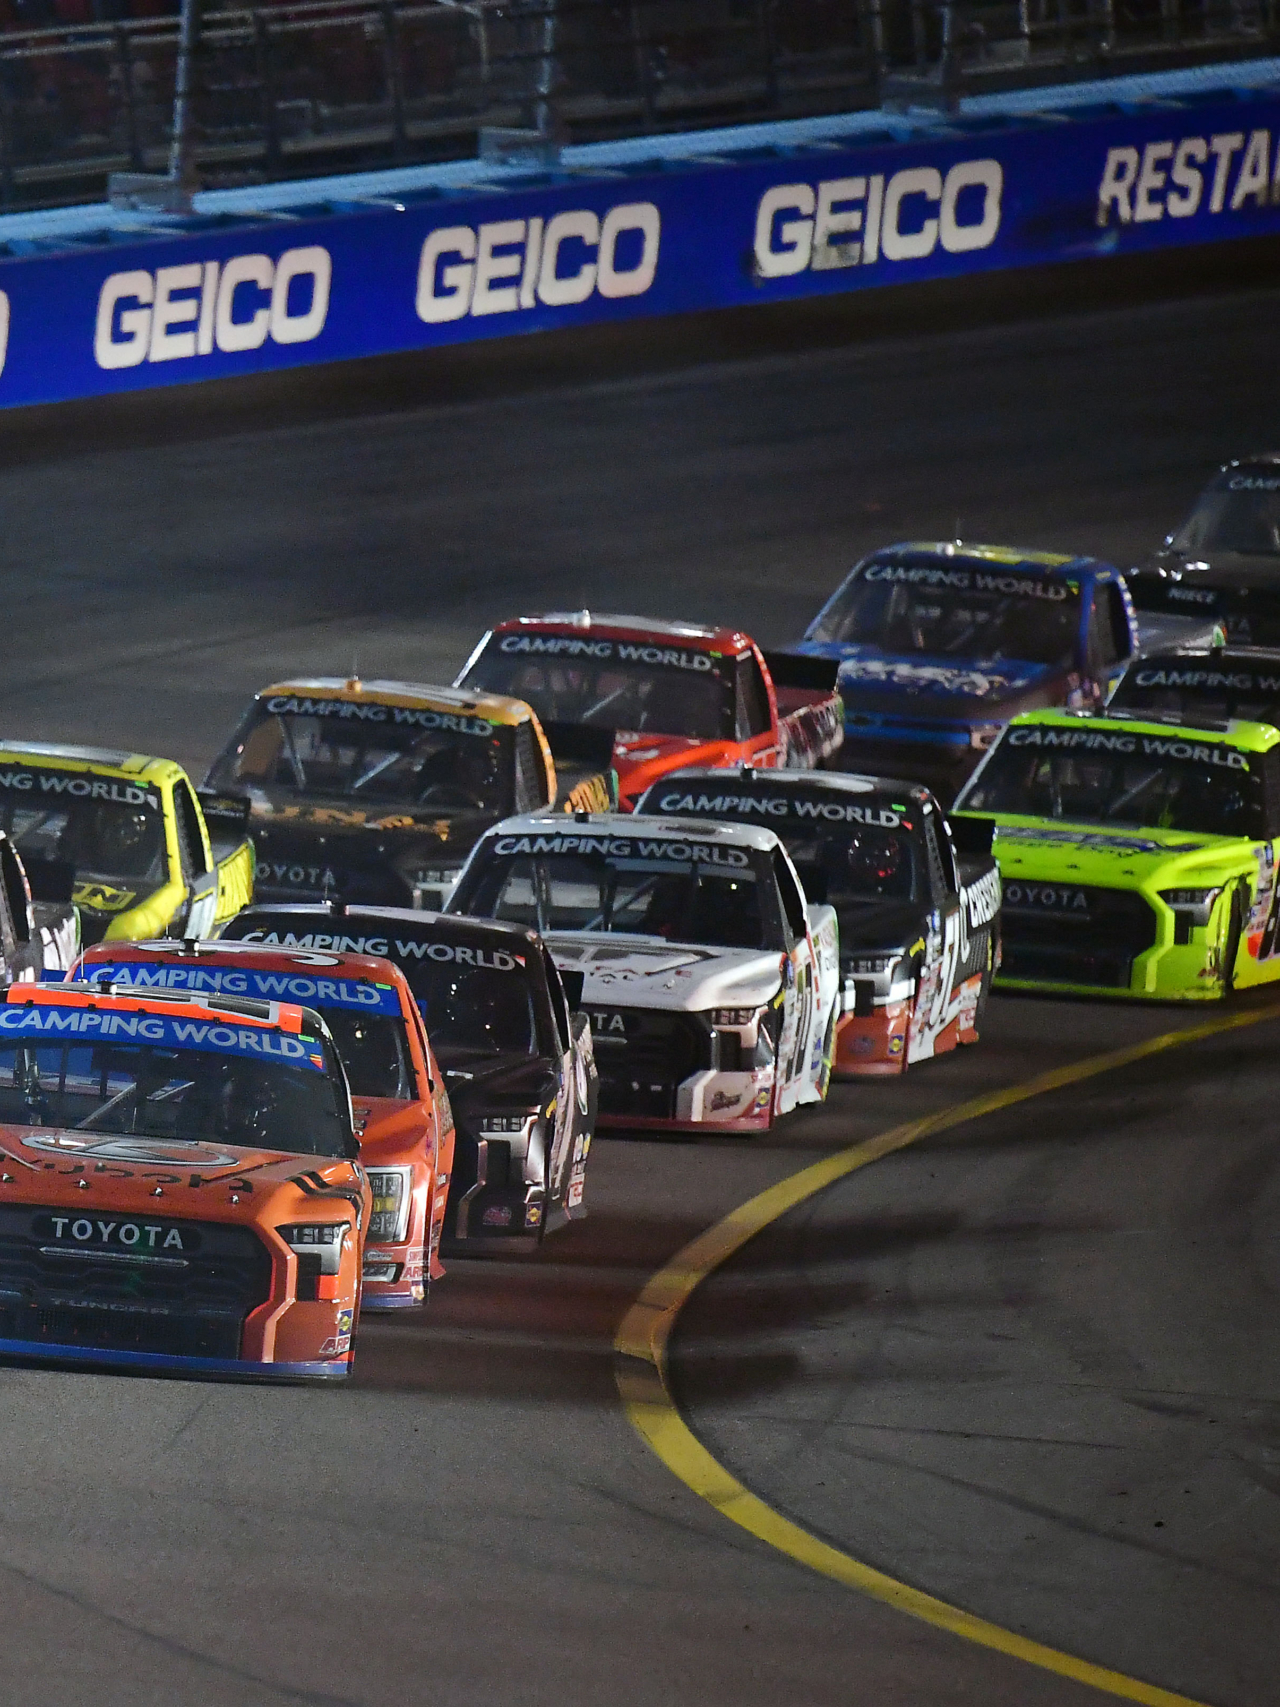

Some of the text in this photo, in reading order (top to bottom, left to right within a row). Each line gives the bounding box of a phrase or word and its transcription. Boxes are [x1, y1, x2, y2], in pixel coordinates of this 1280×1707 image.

[1096, 129, 1280, 227] RESTA
[754, 158, 1004, 281] GEICO
[415, 201, 661, 325] GEICO
[94, 245, 332, 371] GEICO
[864, 564, 1069, 602] CAMPING WORLD
[500, 635, 713, 672] CAMPING WORLD
[1135, 669, 1253, 691] CAMPING
[267, 696, 494, 737] CAMPING WORLD
[1008, 729, 1247, 769] CAMPING WORLD
[39, 774, 145, 806] WORLD
[659, 792, 901, 829] CAMPING WORLD
[494, 836, 750, 868] CAMPING WORLD
[255, 862, 337, 887] OYOTA
[1005, 884, 1088, 909] OYOTA
[394, 939, 517, 972] WORLD
[89, 966, 382, 1006] CAMPING WORLD
[174, 1022, 307, 1059] WORLD
[50, 1216, 185, 1250] TOYOTA
